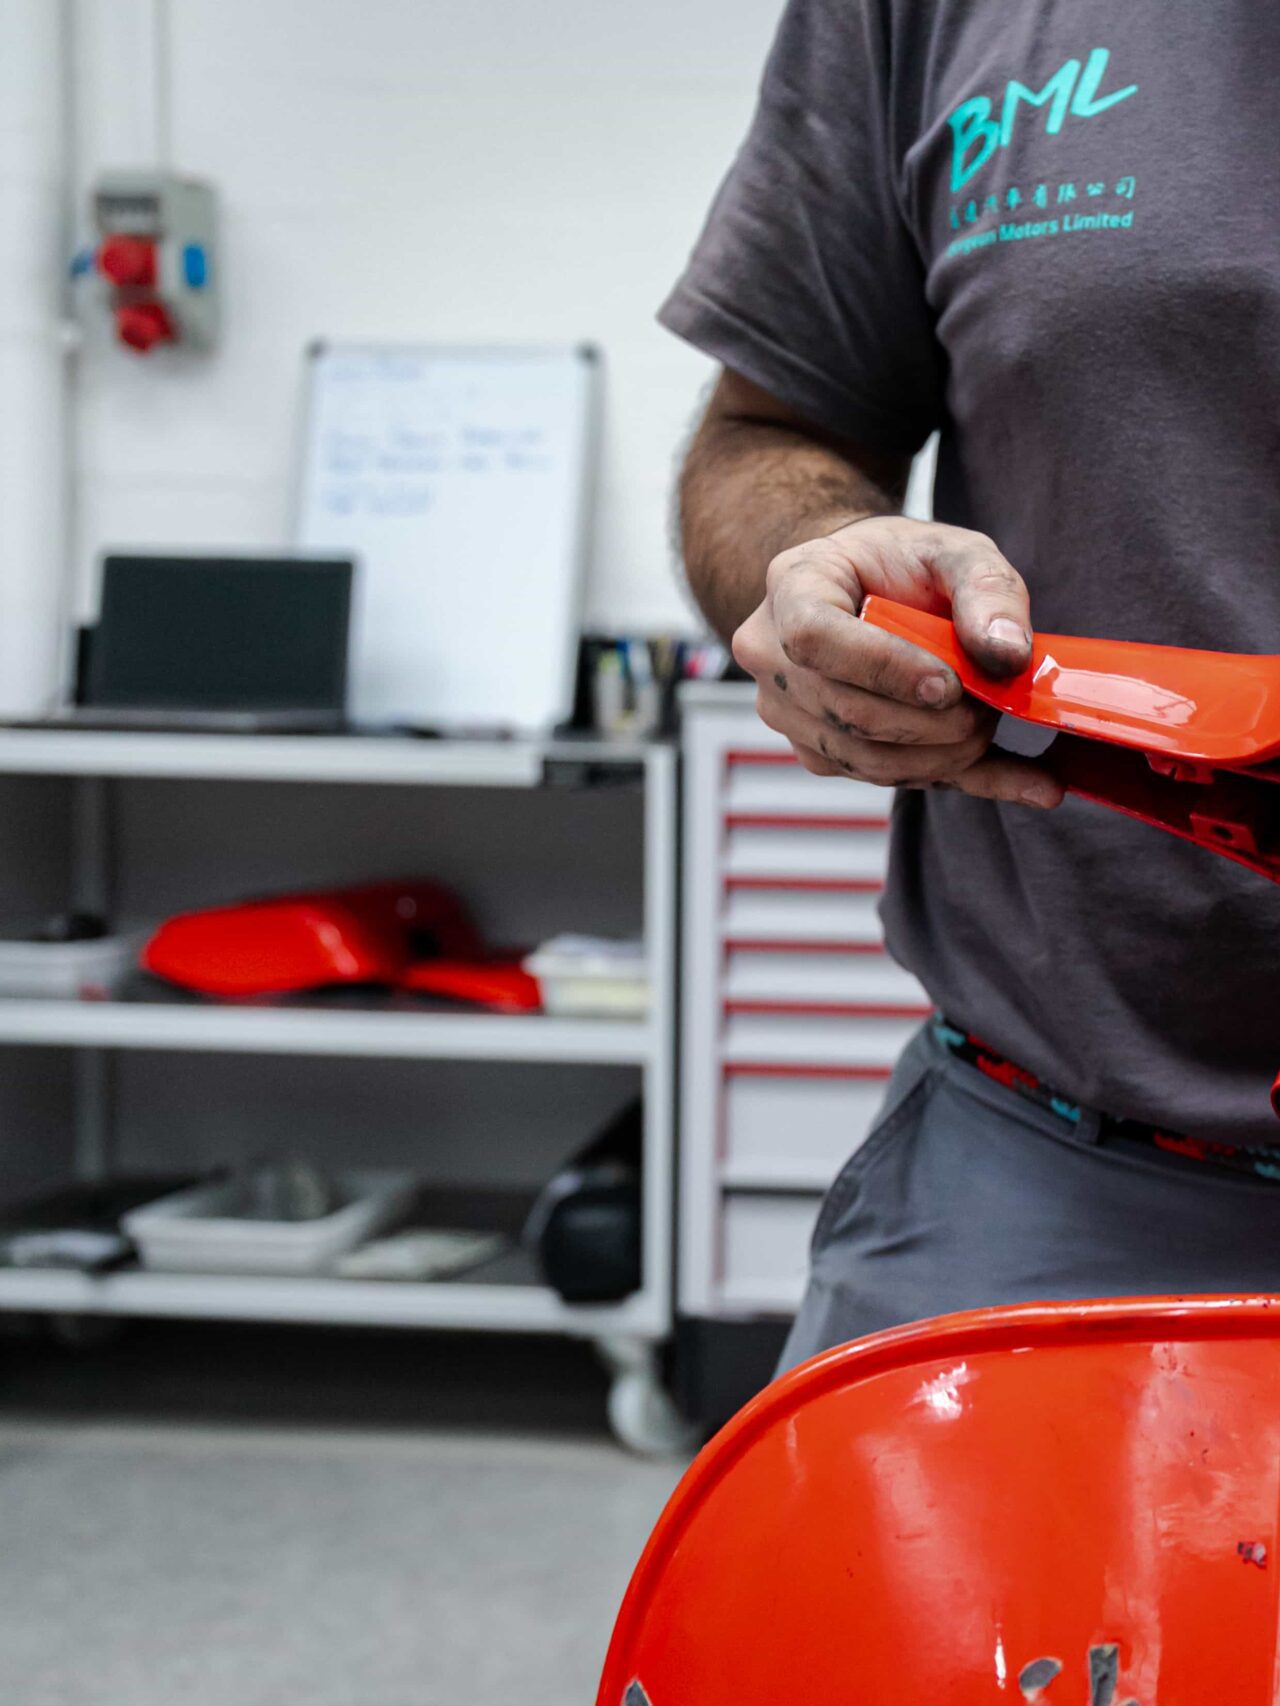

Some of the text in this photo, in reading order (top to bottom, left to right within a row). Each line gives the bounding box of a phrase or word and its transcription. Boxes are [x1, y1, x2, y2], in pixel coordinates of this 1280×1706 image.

[946, 48, 1139, 193] BML
[999, 211, 1134, 240] Motors Limited
